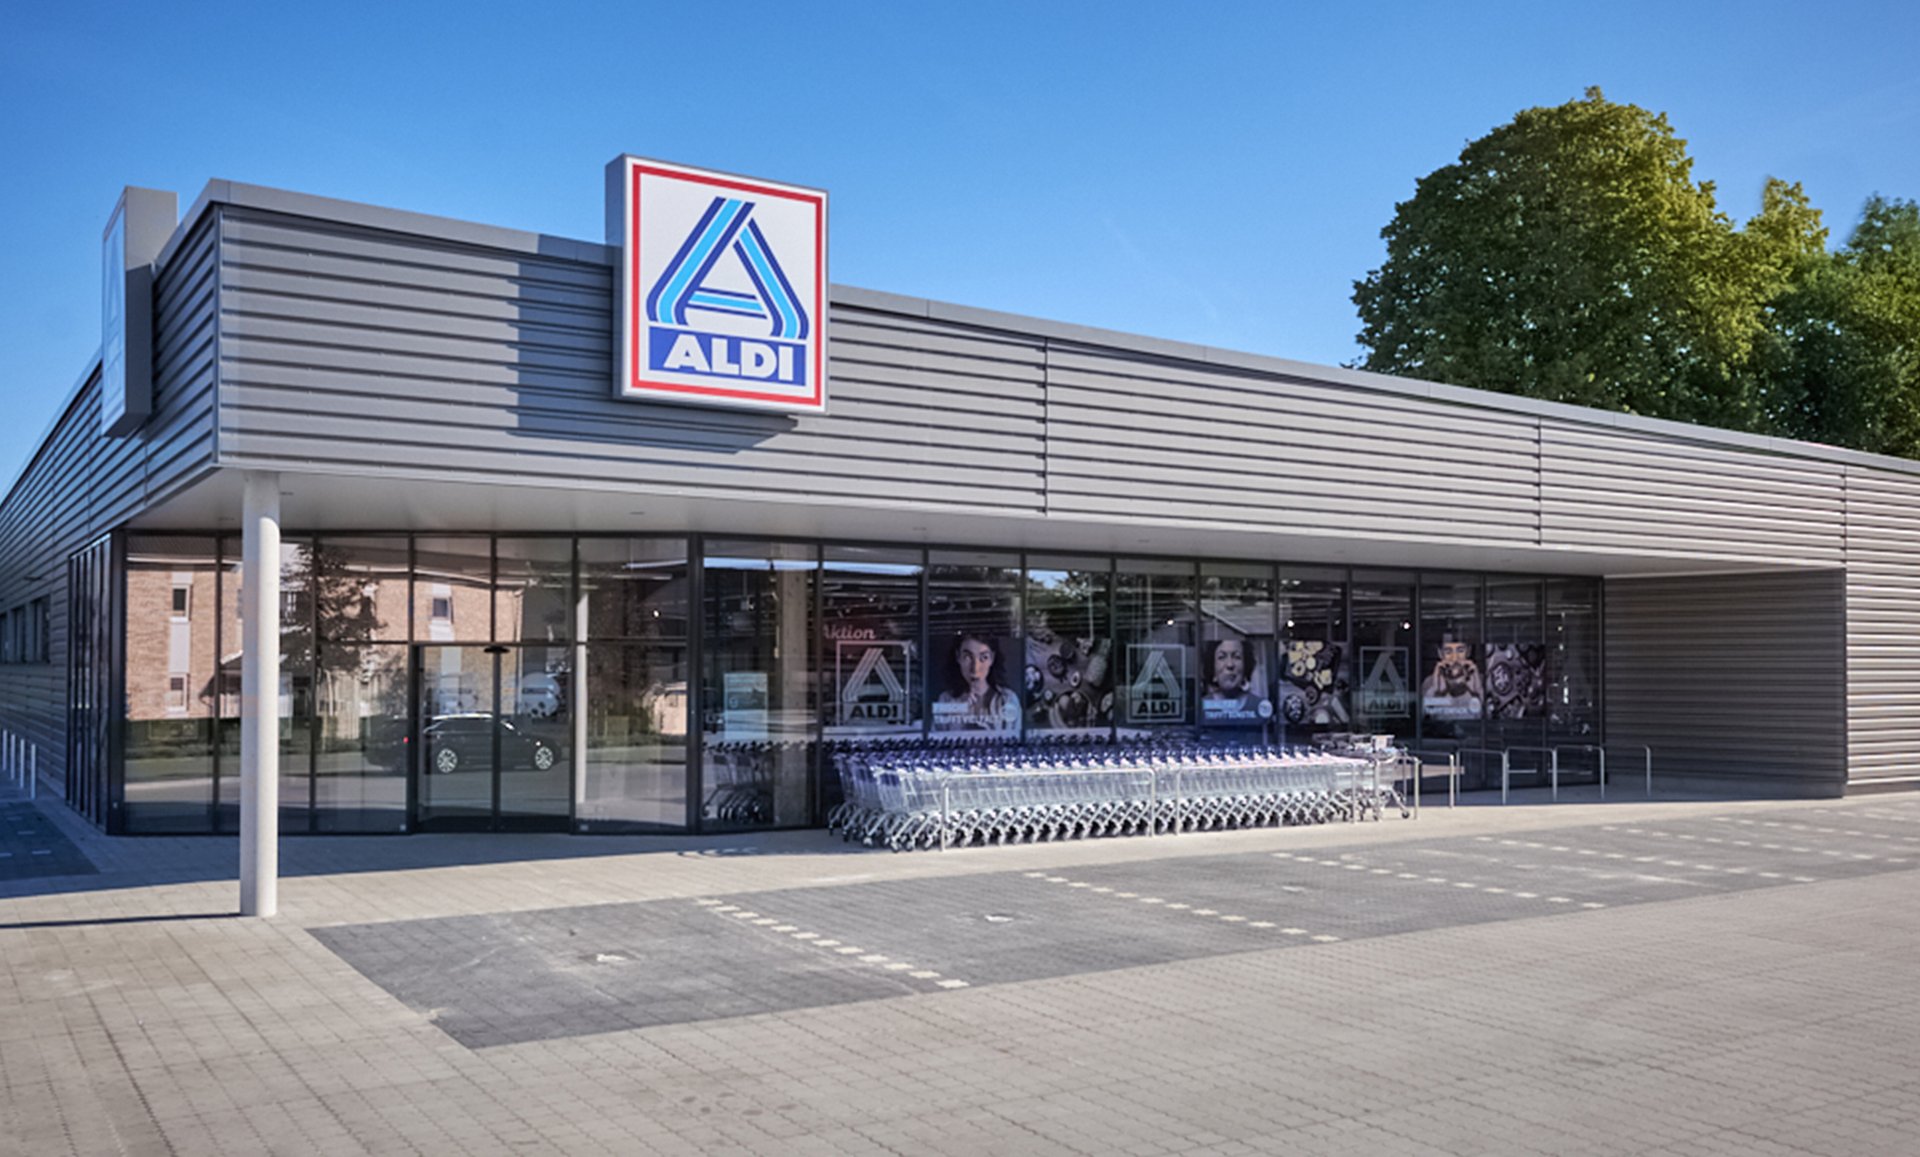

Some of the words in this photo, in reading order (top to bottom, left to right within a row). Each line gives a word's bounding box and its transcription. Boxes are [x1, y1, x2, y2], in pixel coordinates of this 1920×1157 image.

[663, 333, 794, 382] ALDI
[849, 704, 898, 718] ALDI
[1137, 701, 1176, 714] ALDI
